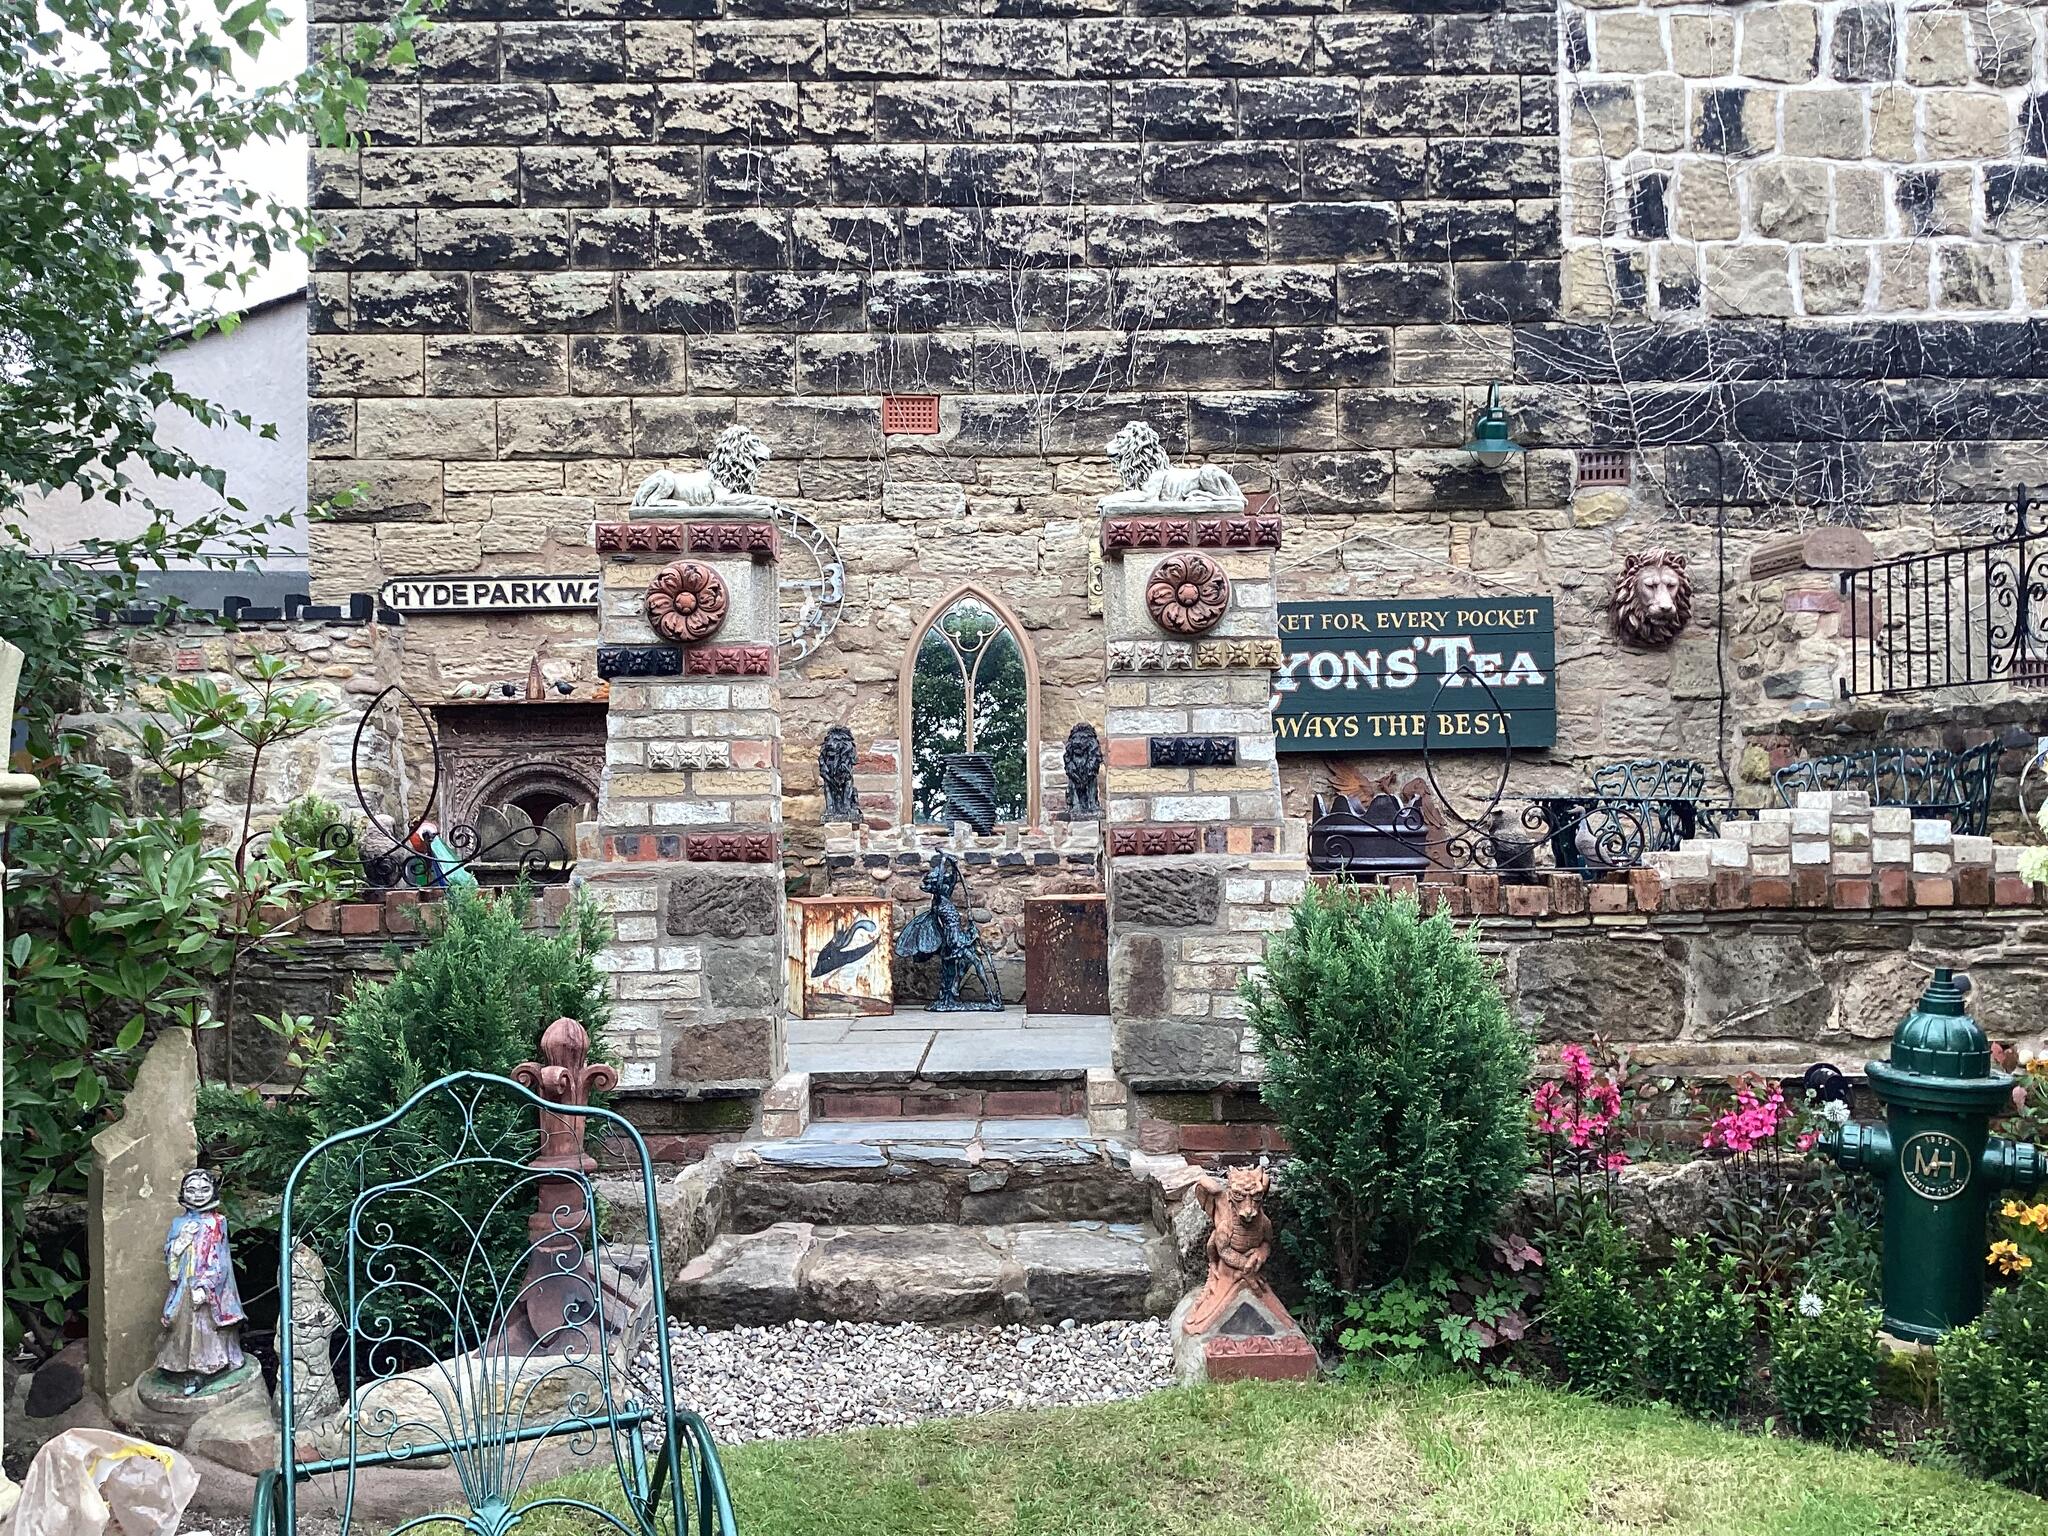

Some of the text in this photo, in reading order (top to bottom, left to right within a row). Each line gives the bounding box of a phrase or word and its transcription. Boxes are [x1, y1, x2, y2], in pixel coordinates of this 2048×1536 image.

[392, 581, 599, 606] HYDE PARK W.2
[819, 562, 845, 603] 3
[1320, 612, 1371, 632] FOR
[1376, 610, 1450, 632] EVERY
[1456, 608, 1539, 629] POCKET
[1271, 635, 1547, 693] YONS' TEA
[1273, 711, 1512, 738] WAYS THE BEST
